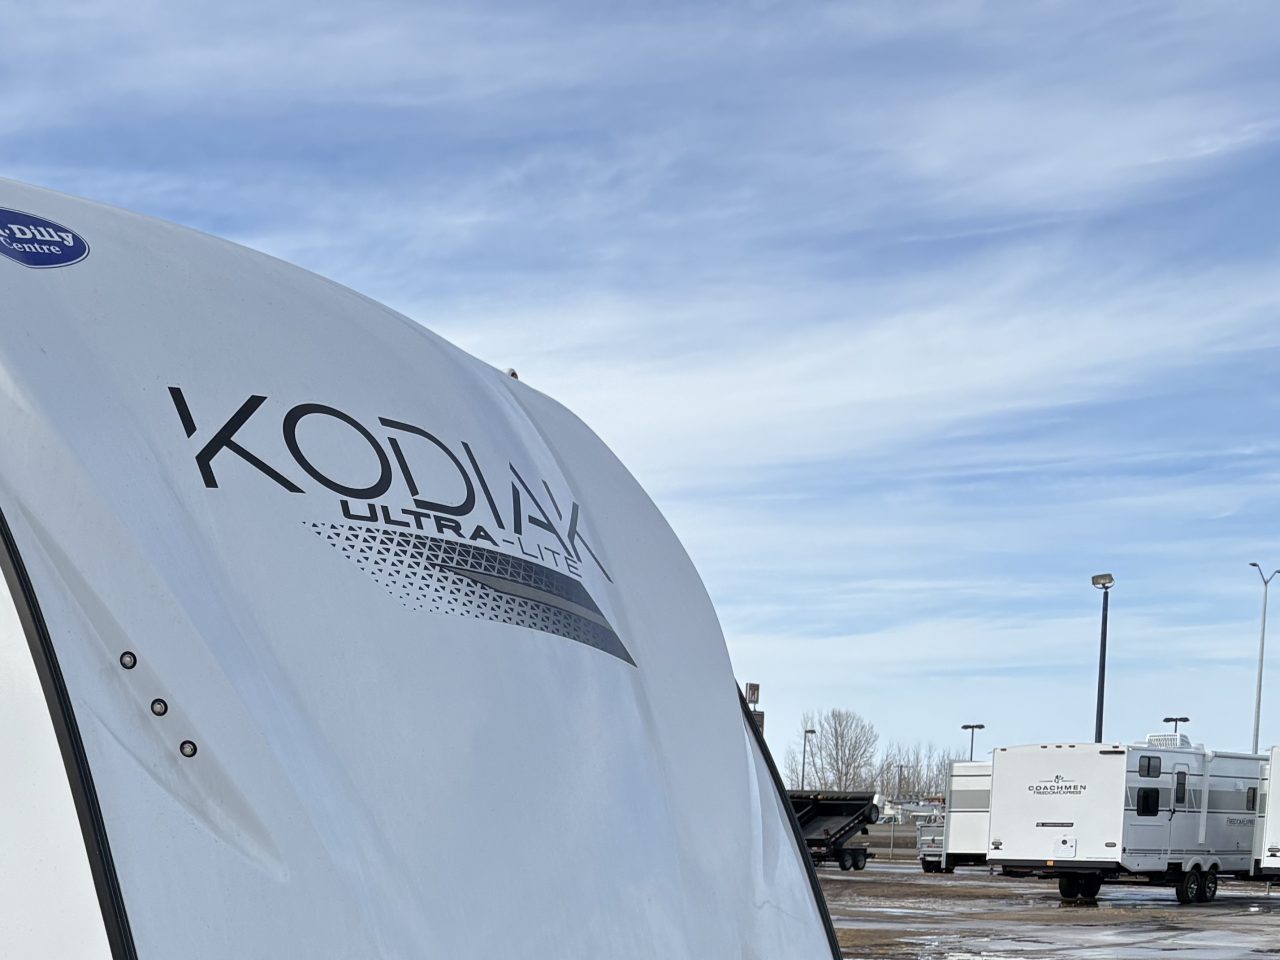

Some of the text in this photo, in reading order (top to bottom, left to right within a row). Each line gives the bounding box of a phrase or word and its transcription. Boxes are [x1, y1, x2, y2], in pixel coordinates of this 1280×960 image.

[0, 237, 62, 254] Centre
[168, 386, 614, 584] KODIAK
[340, 499, 583, 579] ULTRA-LITE
